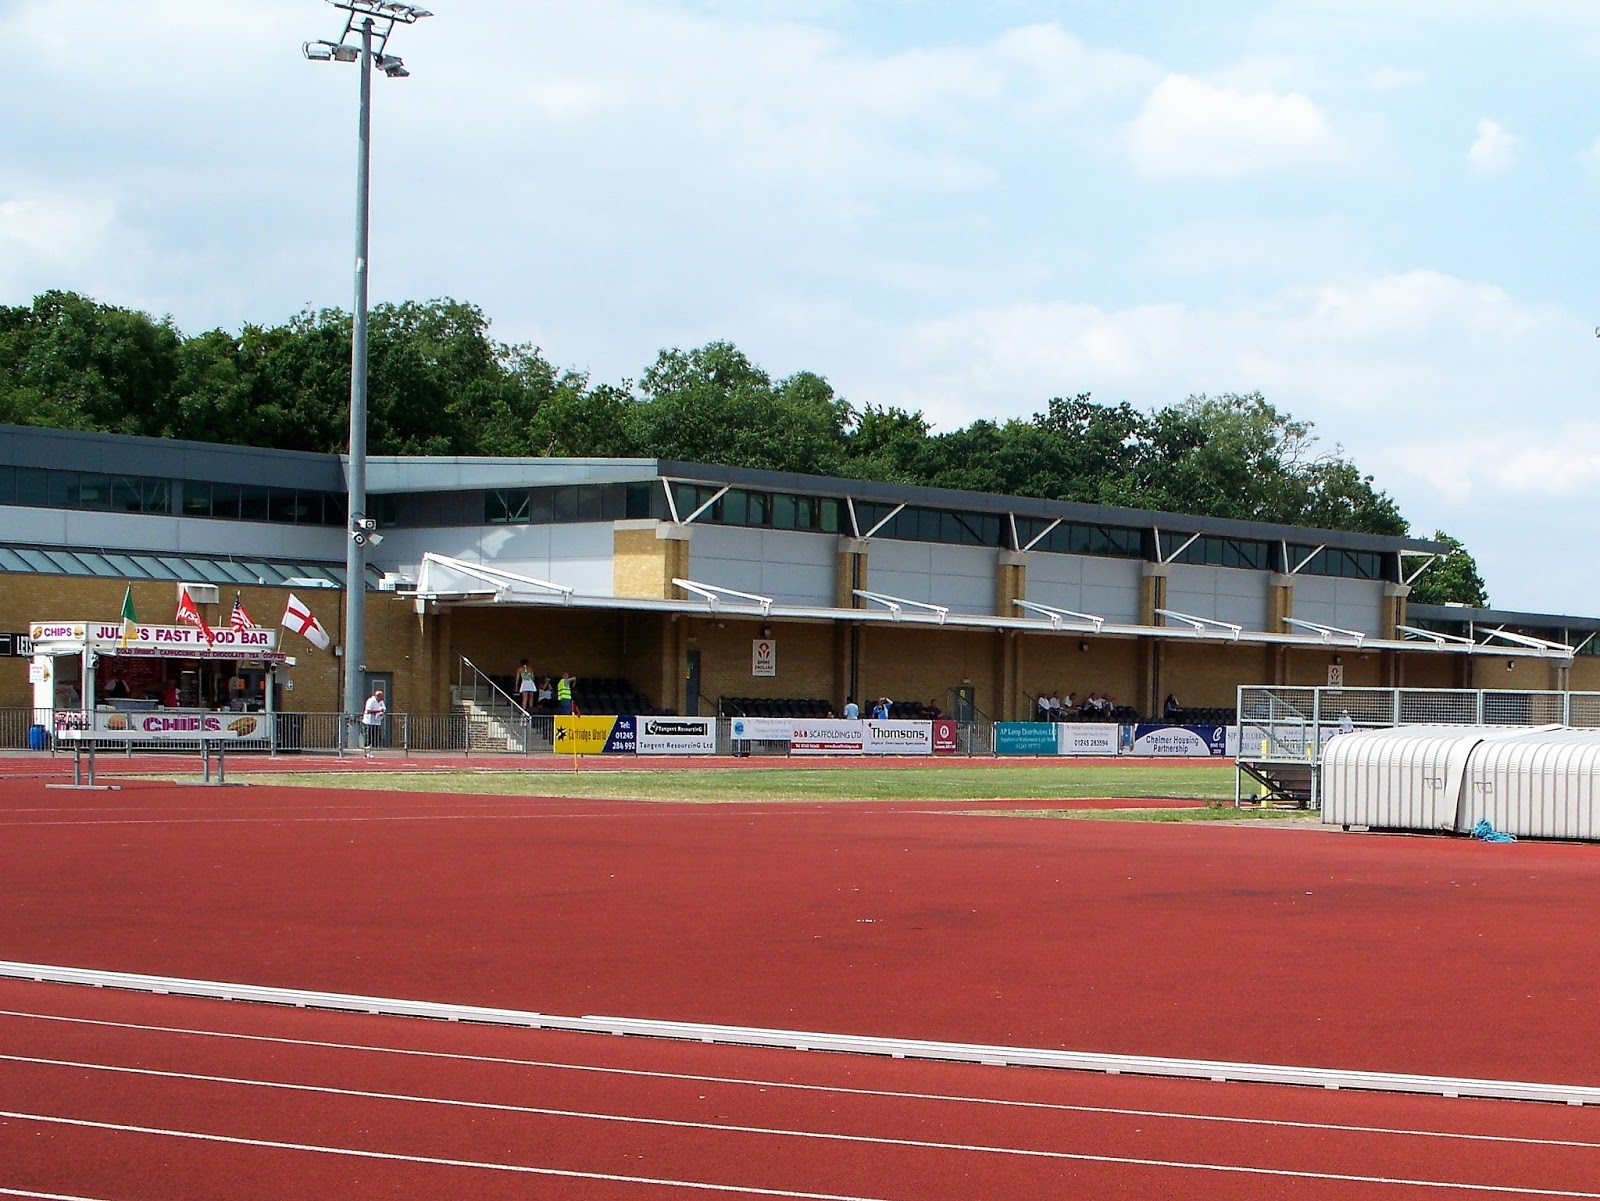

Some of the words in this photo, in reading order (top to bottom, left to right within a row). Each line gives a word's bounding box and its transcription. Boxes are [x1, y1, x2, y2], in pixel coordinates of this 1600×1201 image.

[44, 627, 72, 637] CHIPS
[156, 629, 191, 643] FAST
[240, 633, 268, 645] BAR
[212, 651, 245, 659] CHOCOLATE
[262, 652, 286, 660] COFFEE
[142, 717, 222, 732] CHIPS
[615, 731, 634, 740] 01245
[809, 730, 850, 739] SCAFFOLDING
[851, 731, 862, 739] LTD
[871, 727, 925, 739] Thomsons
[640, 741, 665, 750] Tangent
[703, 741, 713, 749] Ltd
[1145, 735, 1172, 744] Chelmer
[1173, 736, 1199, 746] Housing
[1153, 744, 1189, 754] Partnership
